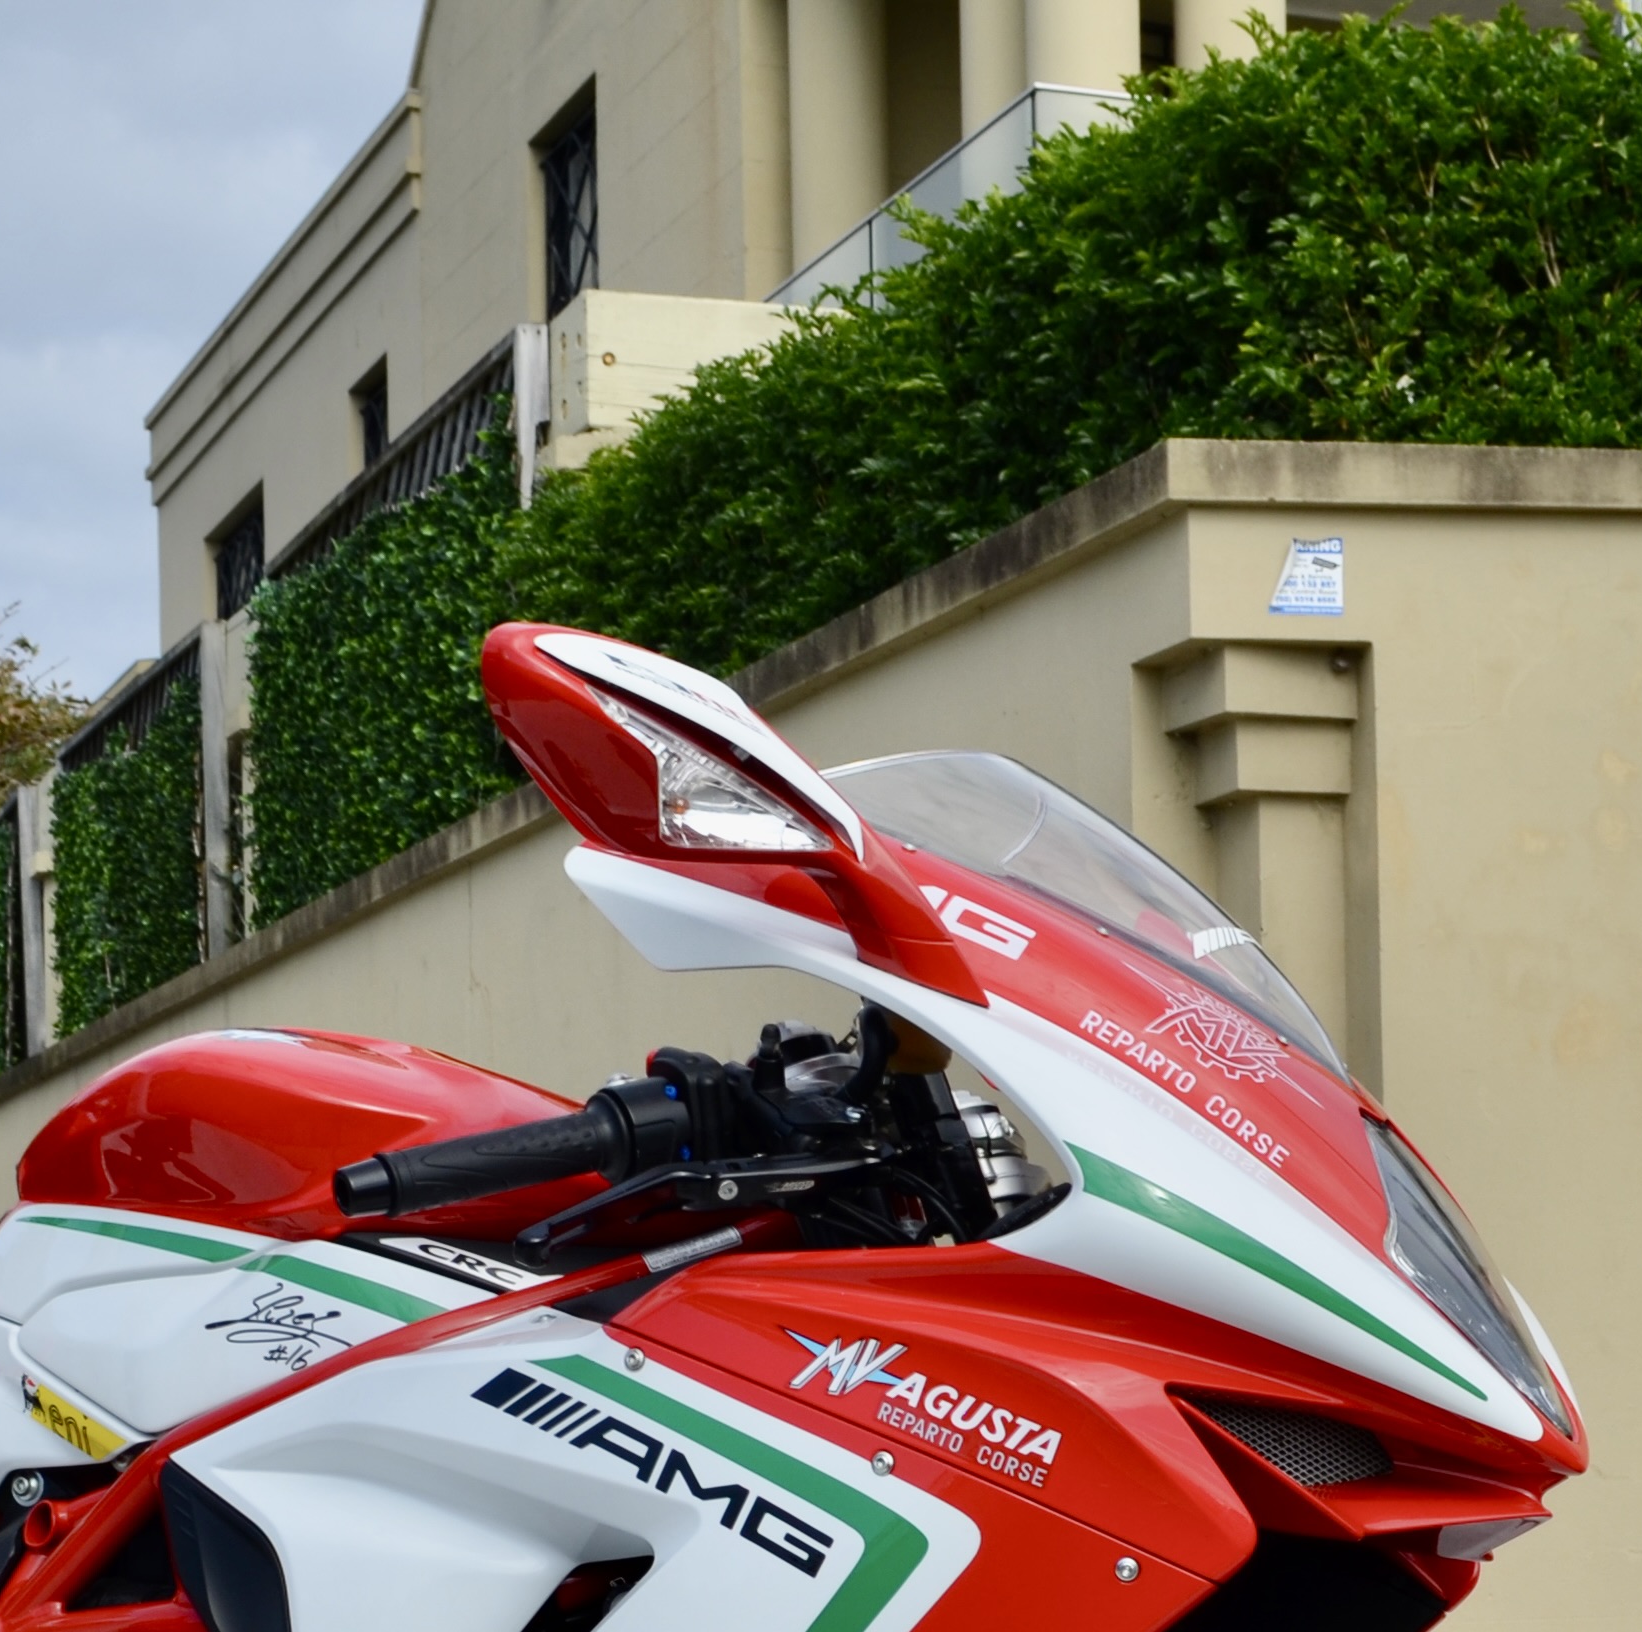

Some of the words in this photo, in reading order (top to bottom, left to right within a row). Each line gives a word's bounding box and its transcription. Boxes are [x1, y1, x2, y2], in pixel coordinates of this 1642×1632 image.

[1079, 1009, 1196, 1094] REPARTO
[1204, 1095, 1291, 1168] CORSE
[417, 1243, 524, 1286] CRC
[264, 1344, 308, 1371] #16
[48, 1404, 92, 1456] eni
[789, 1338, 908, 1396] MV
[885, 1372, 1062, 1465] AGUSTA
[877, 1402, 964, 1453] REPARTO
[977, 1445, 1048, 1488] CORSE
[578, 1417, 834, 1578] AMG
